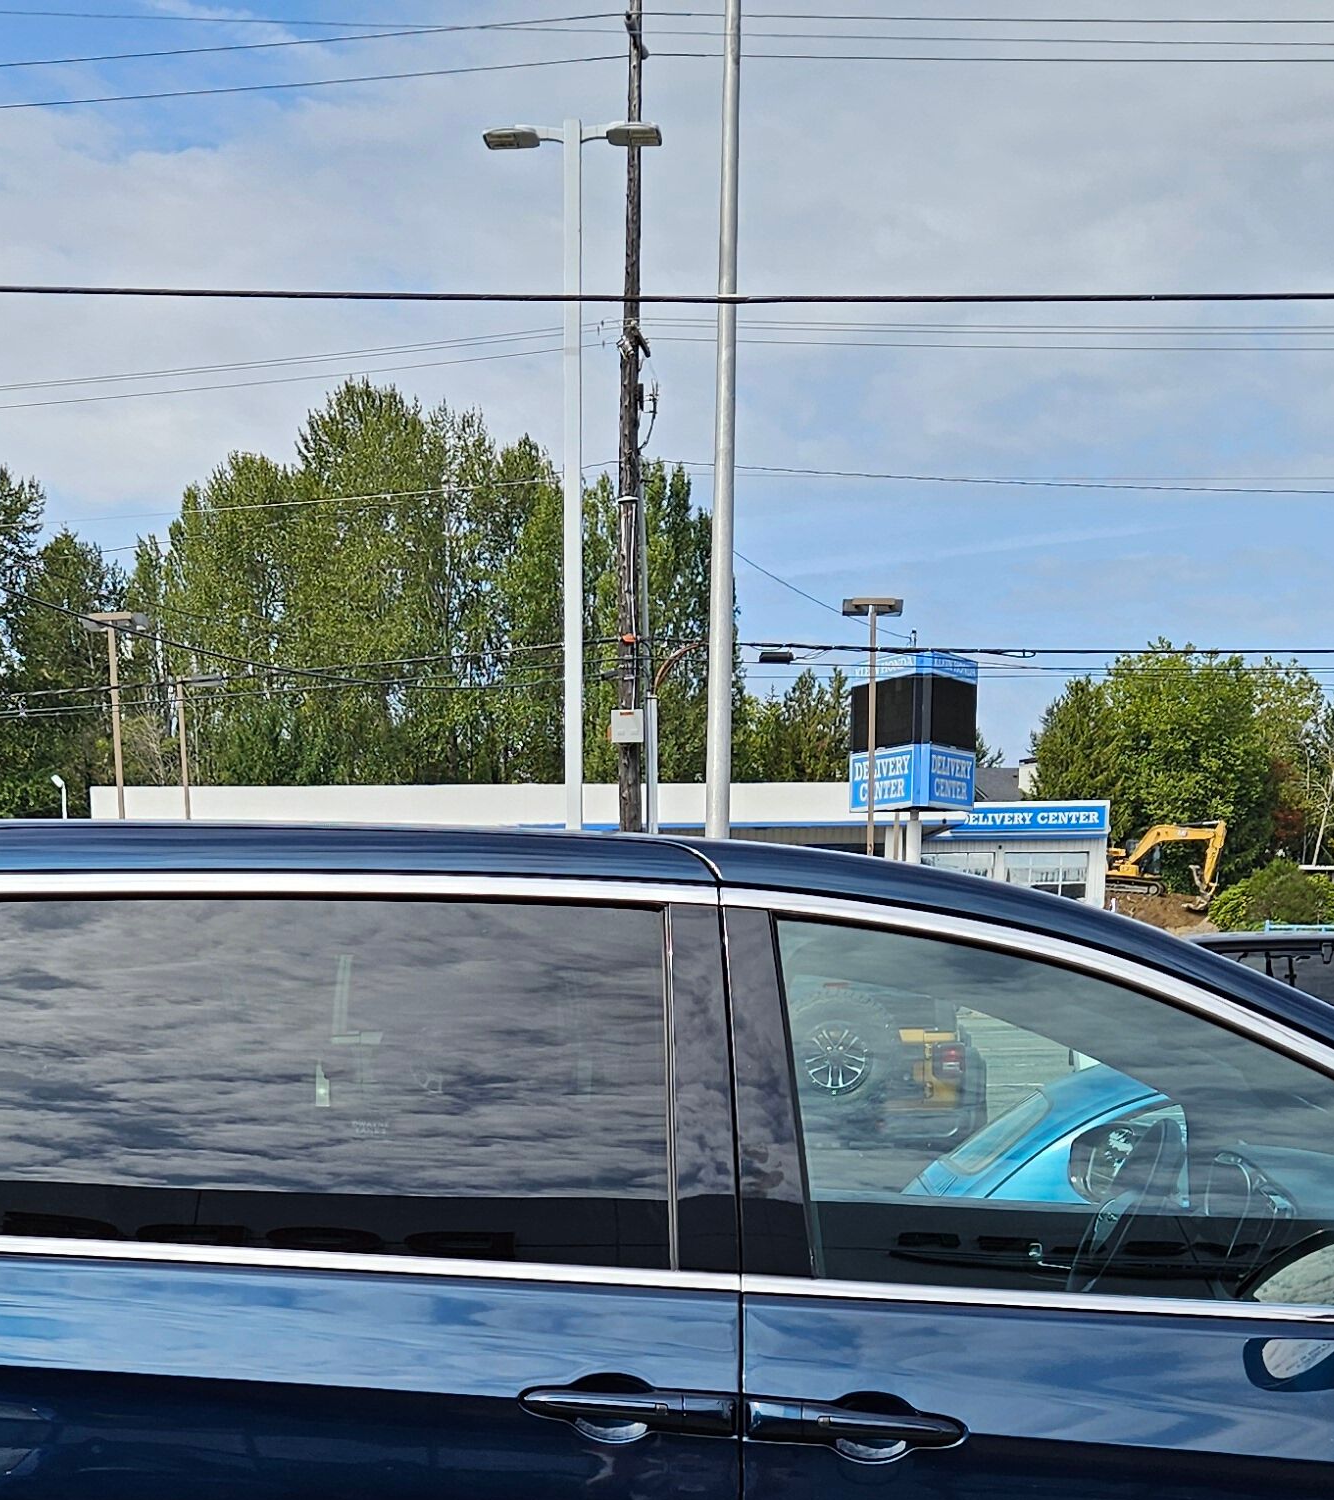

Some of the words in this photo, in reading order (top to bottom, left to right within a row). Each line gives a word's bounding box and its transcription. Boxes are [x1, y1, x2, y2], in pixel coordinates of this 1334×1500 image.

[931, 754, 972, 779] DELIVERY
[859, 778, 905, 802] CNTER
[934, 778, 967, 800] CENTER
[1036, 811, 1099, 825] CENTER
